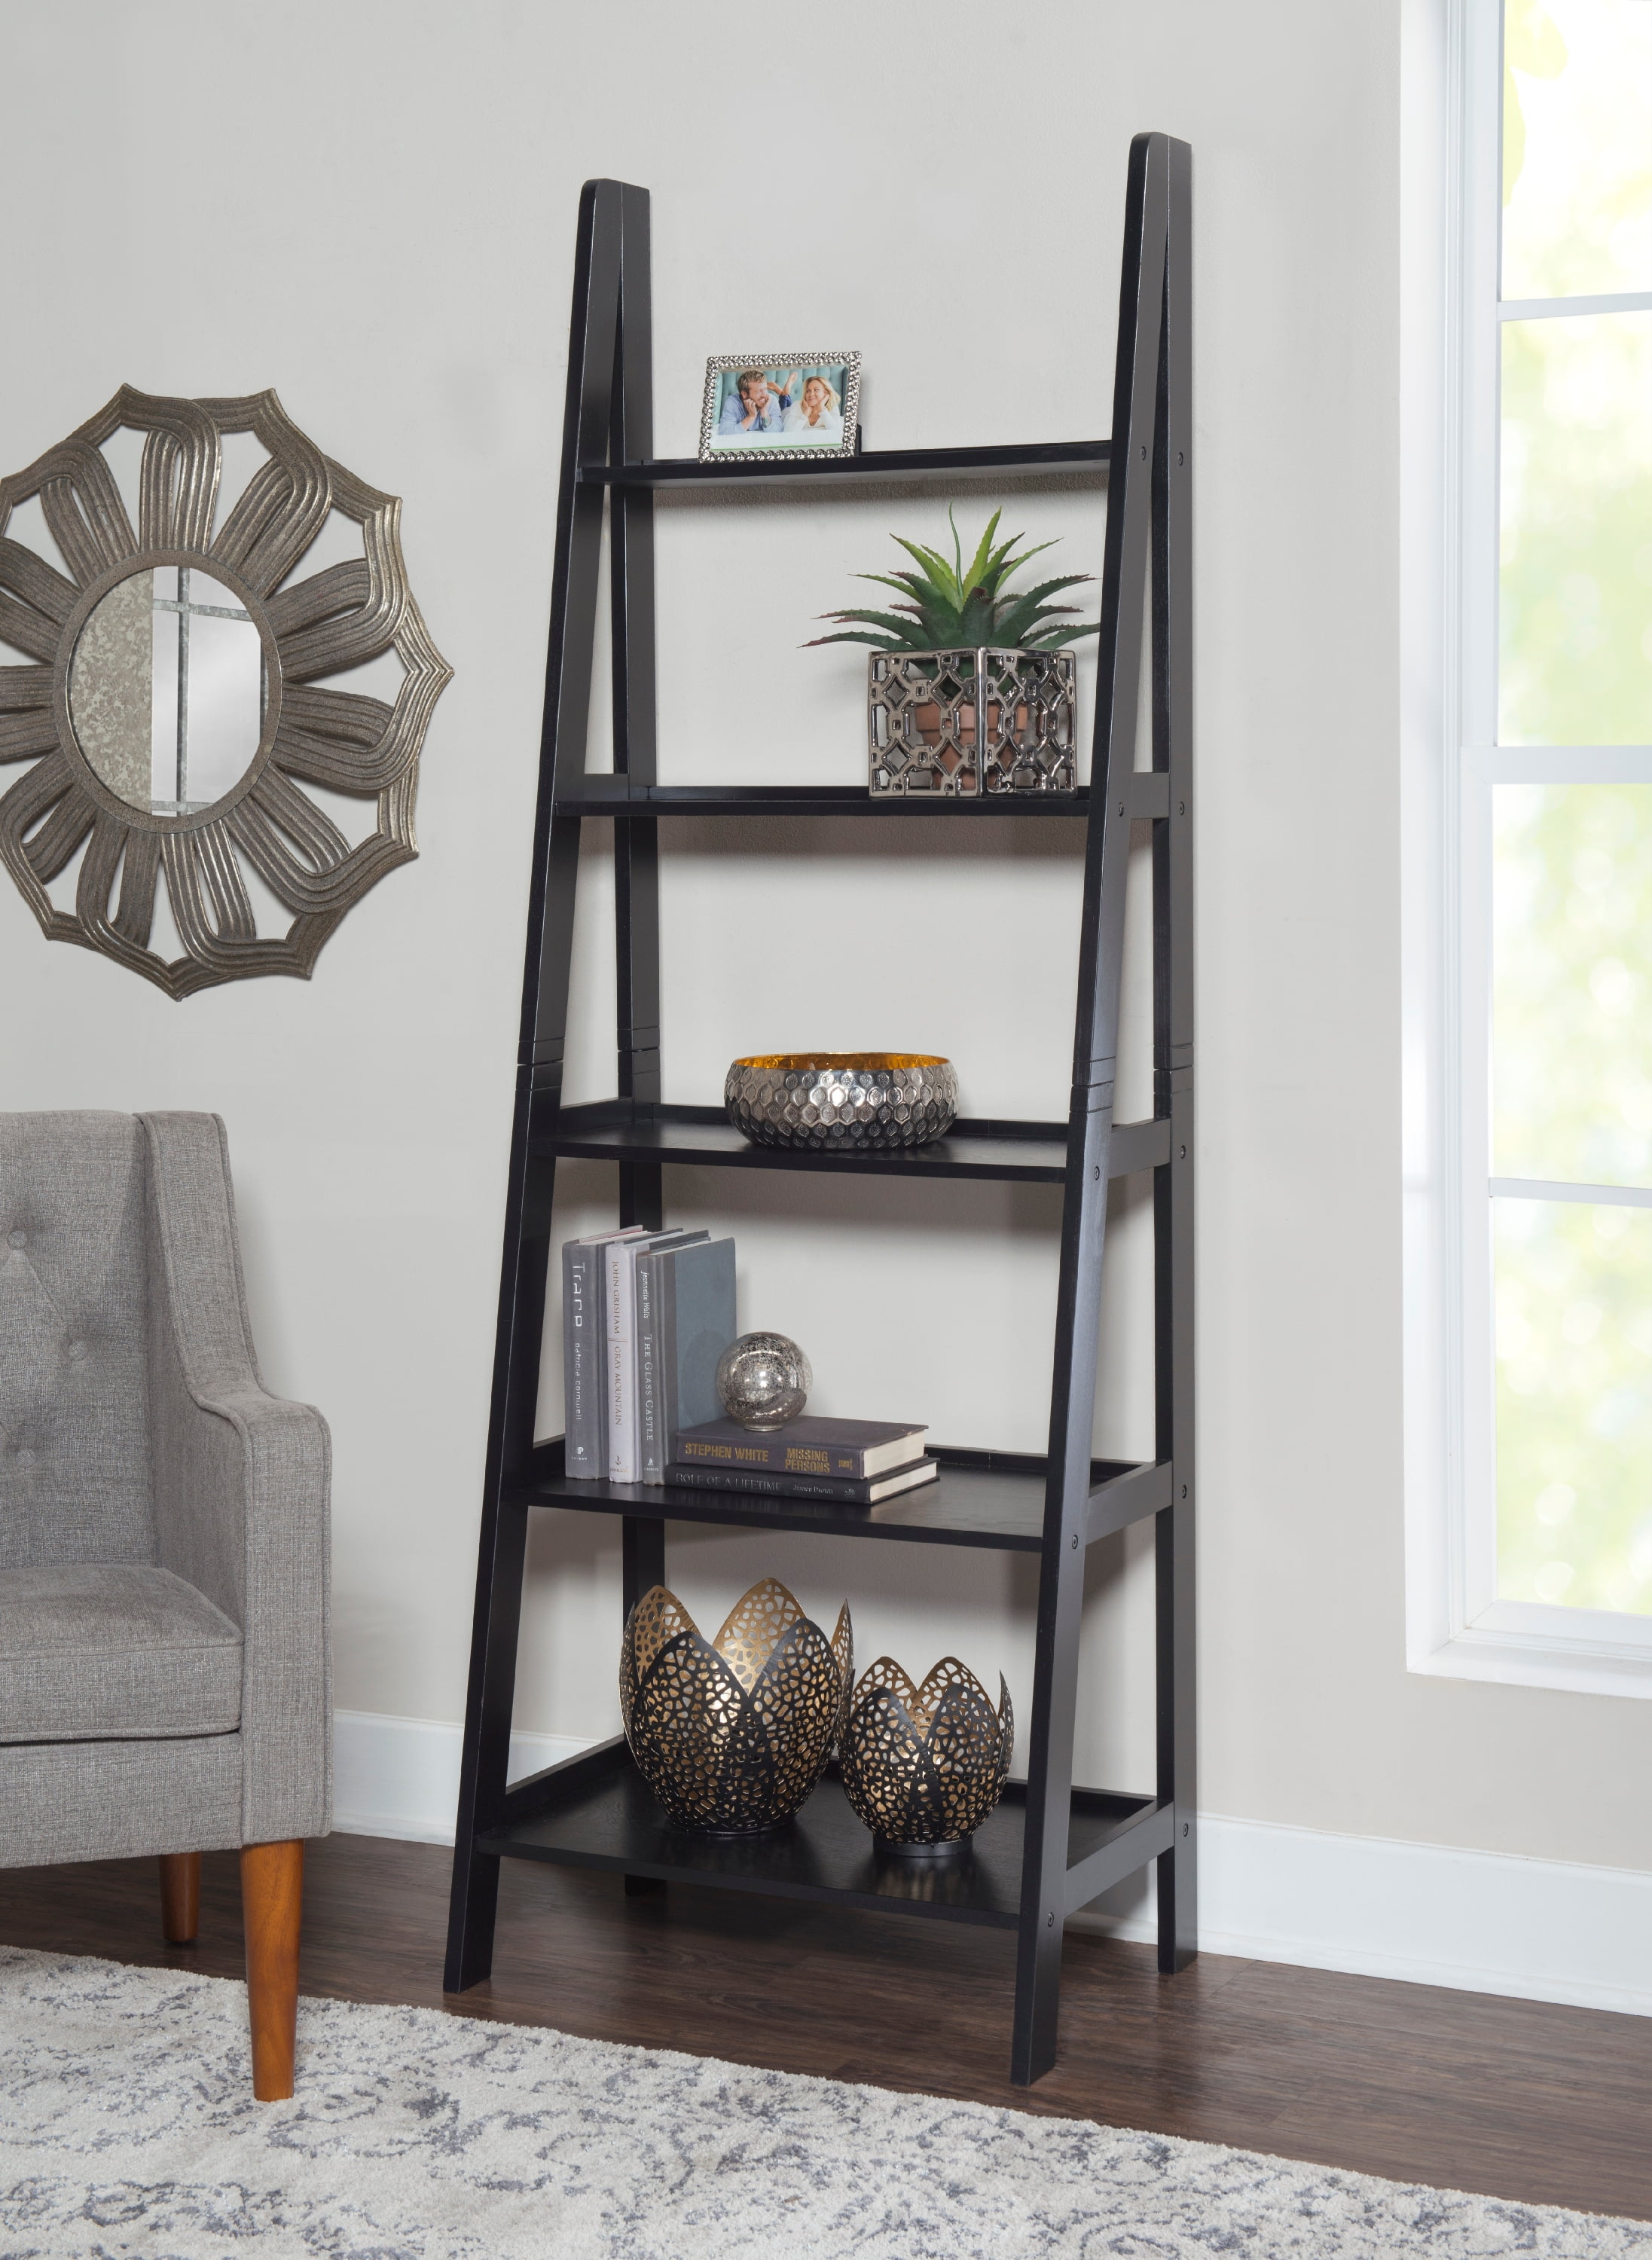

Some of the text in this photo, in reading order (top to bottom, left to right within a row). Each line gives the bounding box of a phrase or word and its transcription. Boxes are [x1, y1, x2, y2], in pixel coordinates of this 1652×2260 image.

[612, 1261, 620, 1286] JOHN
[641, 1270, 651, 1318] Jeannette Walls
[644, 1334, 654, 1440] THE GLASS CASTLE
[685, 1443, 768, 1462] STEPHEN WHITE
[786, 1447, 828, 1462] MISSING
[785, 1458, 830, 1474] PERSONS
[676, 1473, 783, 1491] ROLE OF A LIFETIME
